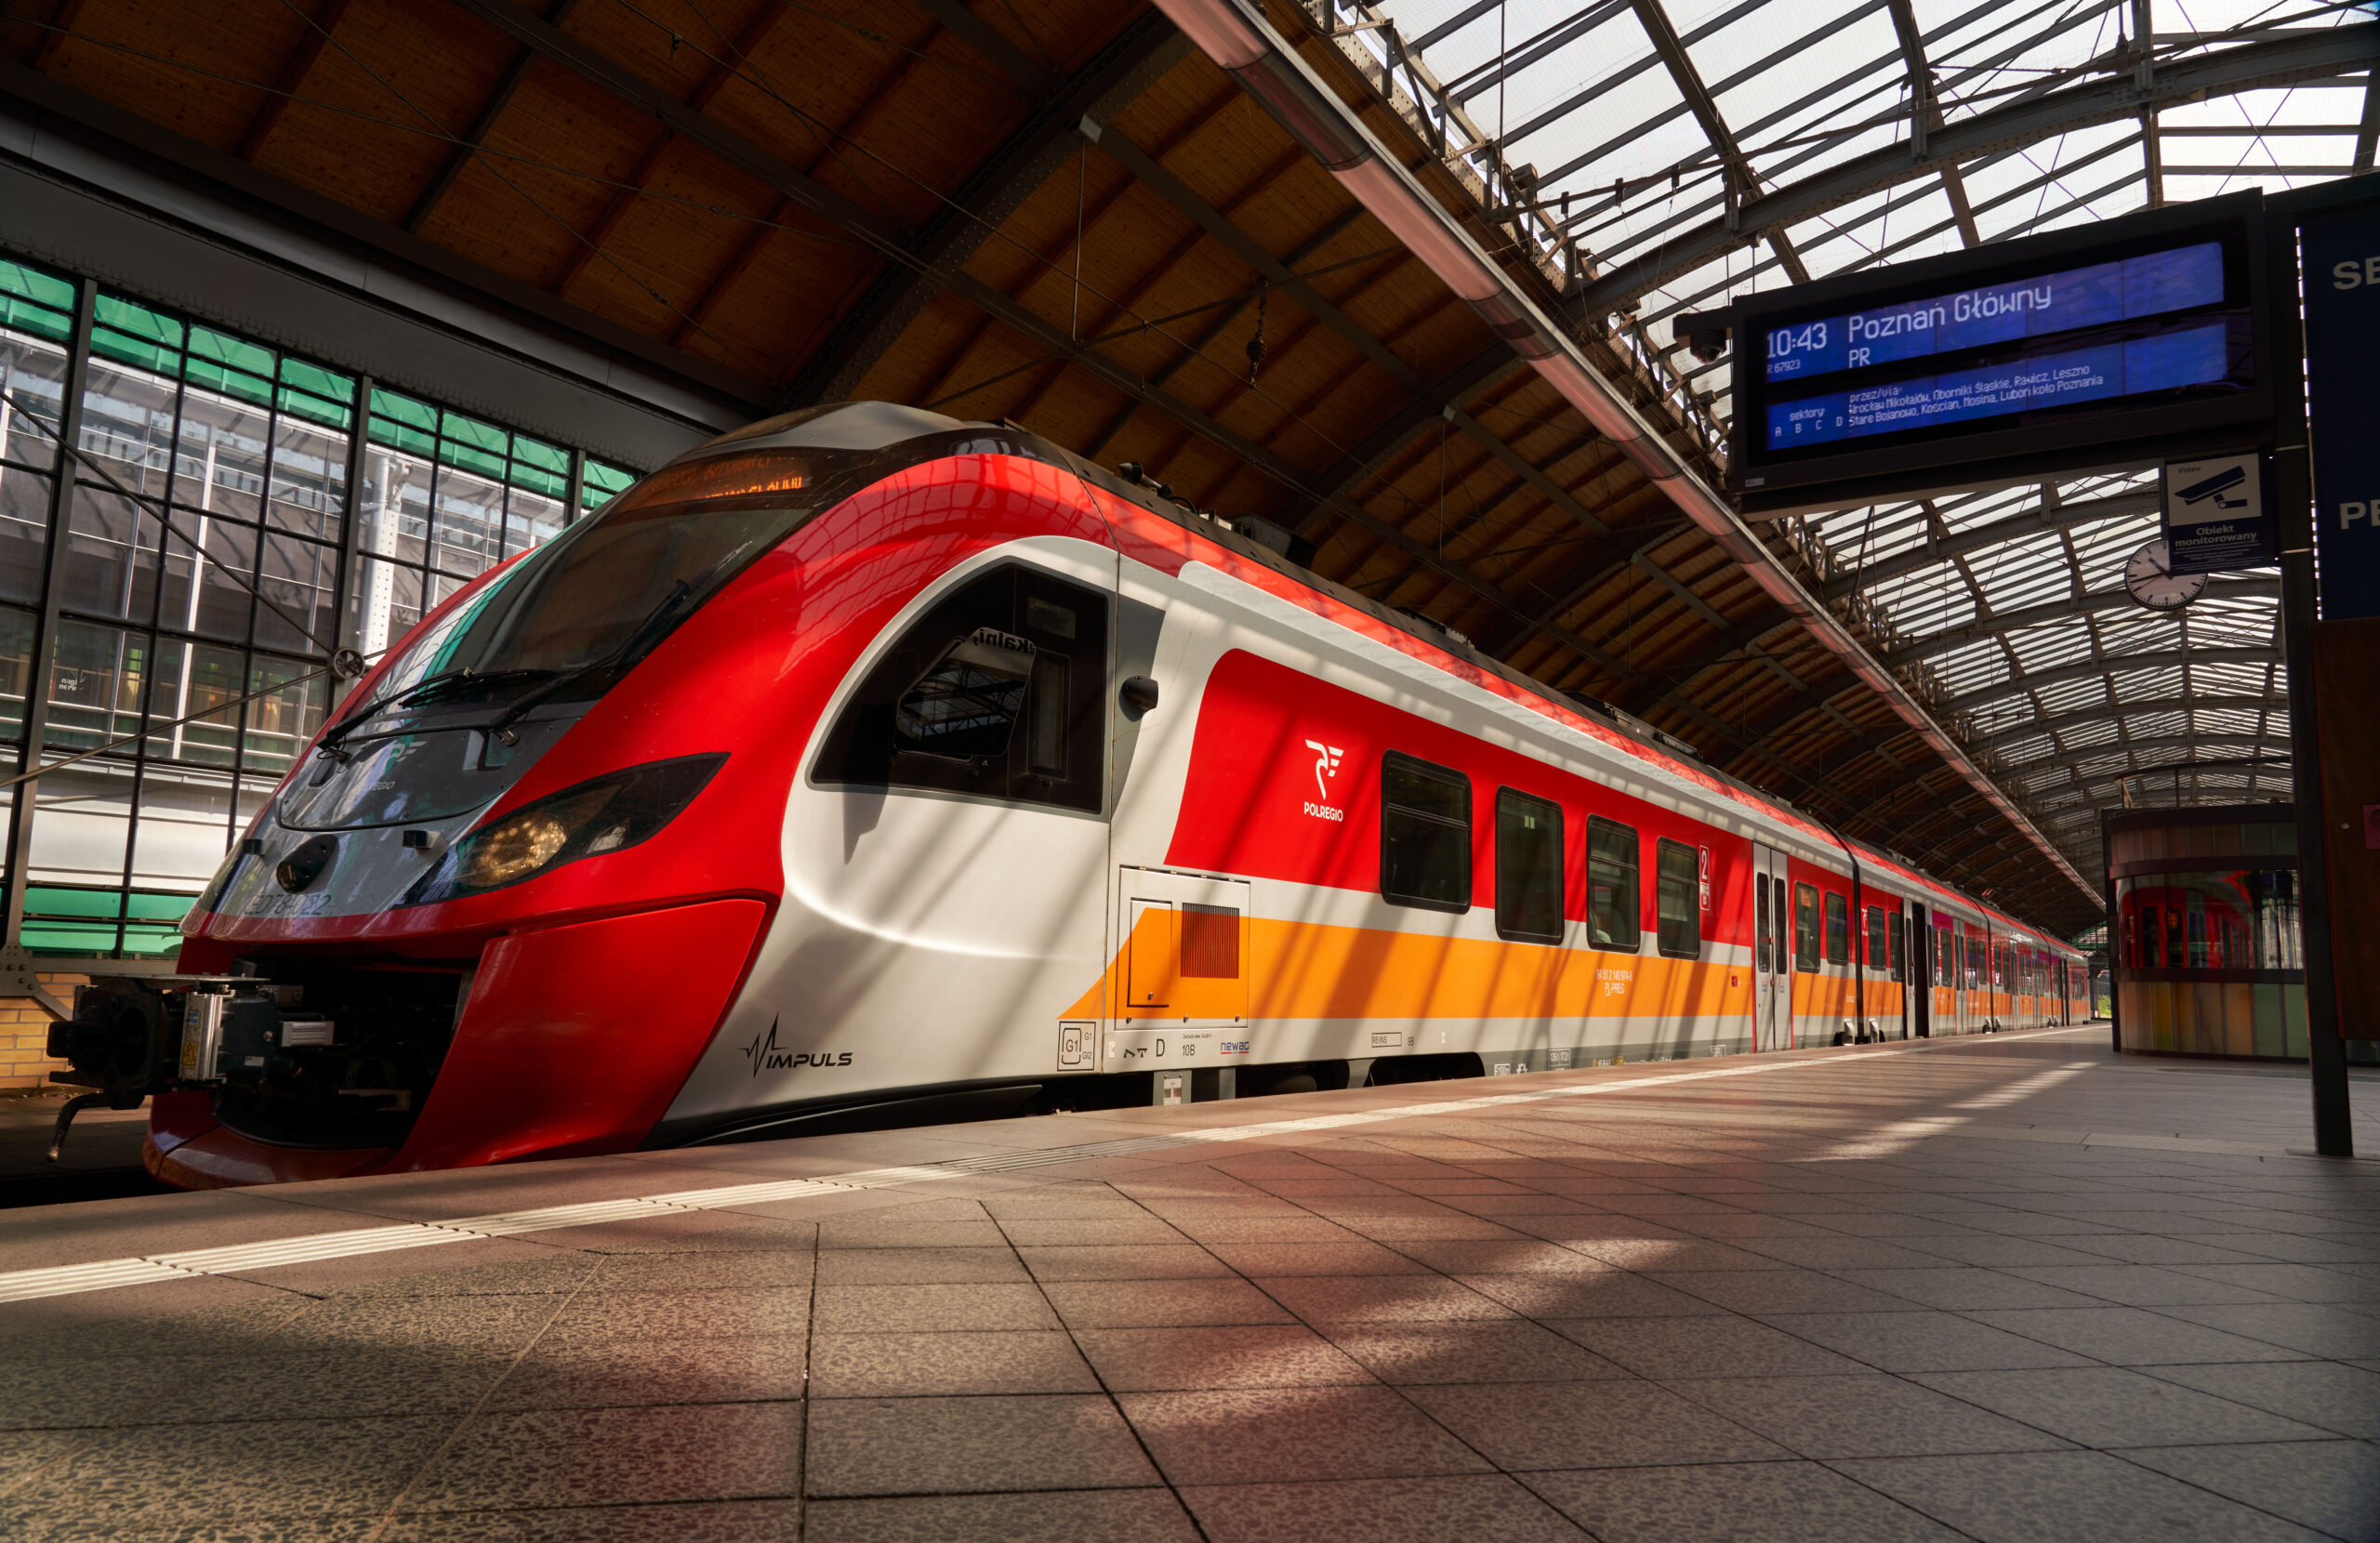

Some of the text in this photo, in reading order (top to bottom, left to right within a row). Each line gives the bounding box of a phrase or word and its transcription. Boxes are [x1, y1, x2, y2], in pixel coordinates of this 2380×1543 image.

[1766, 285, 2051, 359] 10:43 Poznań Główny
[1774, 359, 1801, 374] 67923
[1848, 348, 1871, 369] PR
[1933, 384, 1973, 401] Oborniki
[2053, 364, 2090, 380] Leszno
[1848, 414, 1874, 427] Stare
[2032, 382, 2056, 395] koło
[2056, 374, 2104, 392] Poznania
[1774, 415, 1844, 438] A B C D
[2175, 532, 2257, 547] monitorowany
[2196, 524, 2234, 536] Obiekt
[1303, 801, 1343, 822] POLREGIO
[1701, 850, 1708, 880] 2
[1065, 1032, 1092, 1052] G1 G1
[1156, 1038, 1165, 1057] D
[1182, 1044, 1196, 1057] 10B
[766, 1052, 853, 1069] IMPULS
